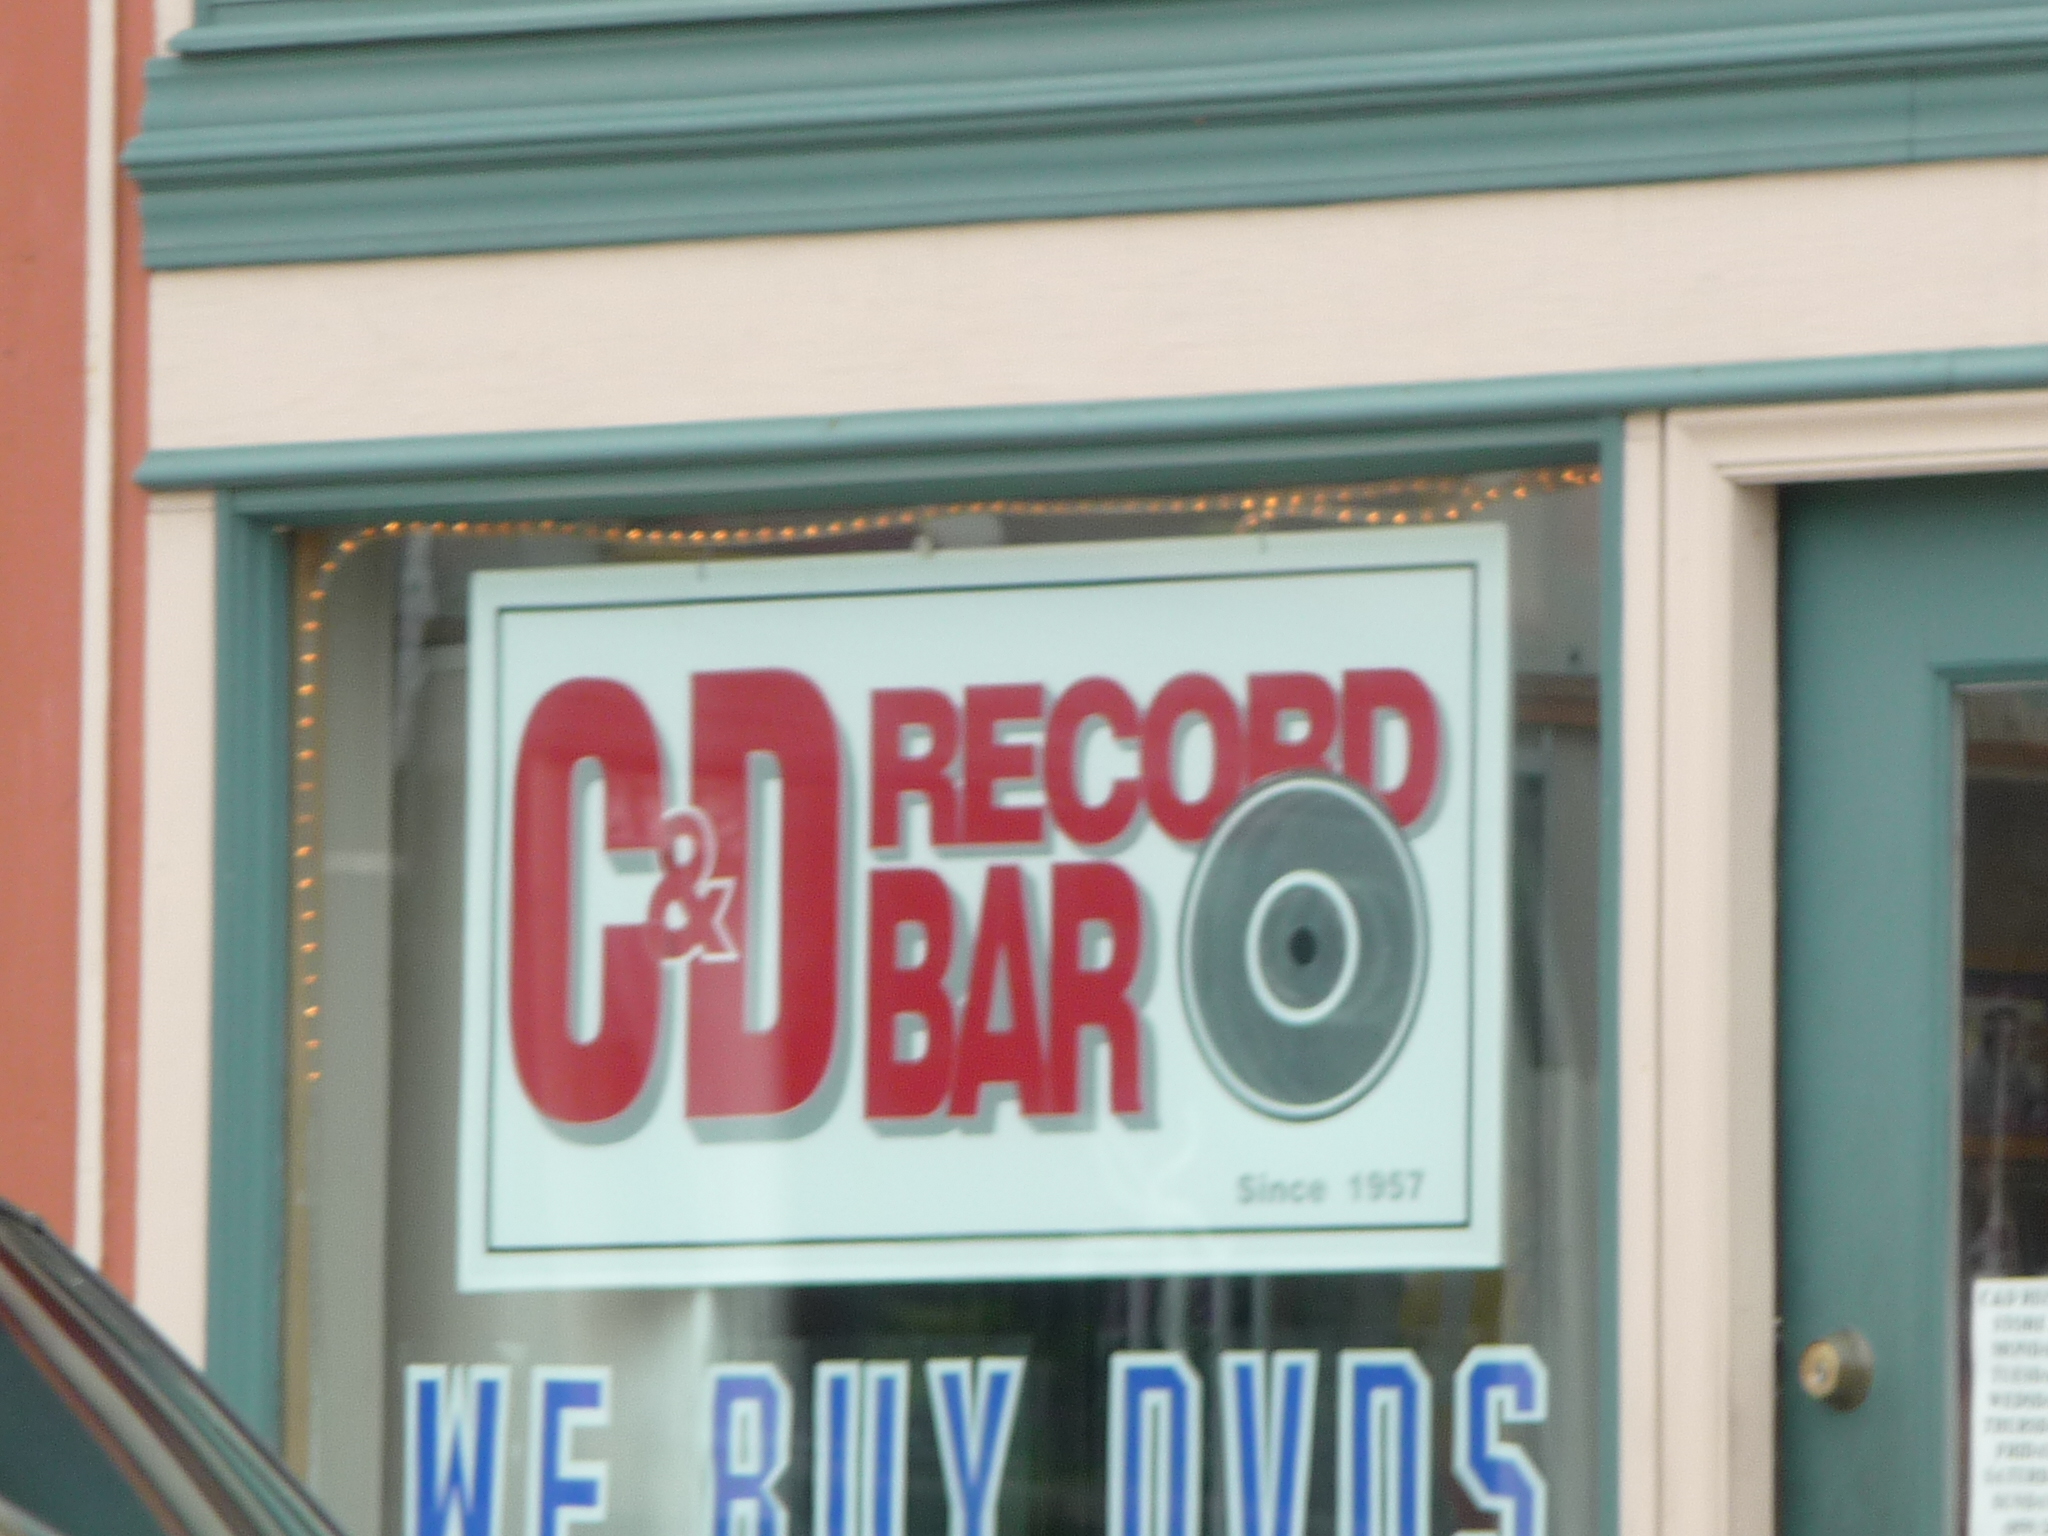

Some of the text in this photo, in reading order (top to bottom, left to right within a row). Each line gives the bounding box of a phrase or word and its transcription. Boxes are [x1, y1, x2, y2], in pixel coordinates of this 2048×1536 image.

[869, 668, 1448, 850] RECORD
[509, 666, 852, 1143] C&D
[864, 862, 1156, 1134] BAR
[1237, 1169, 1425, 1203] Since 1957
[405, 1345, 1549, 1536] WE BUY DVDS
